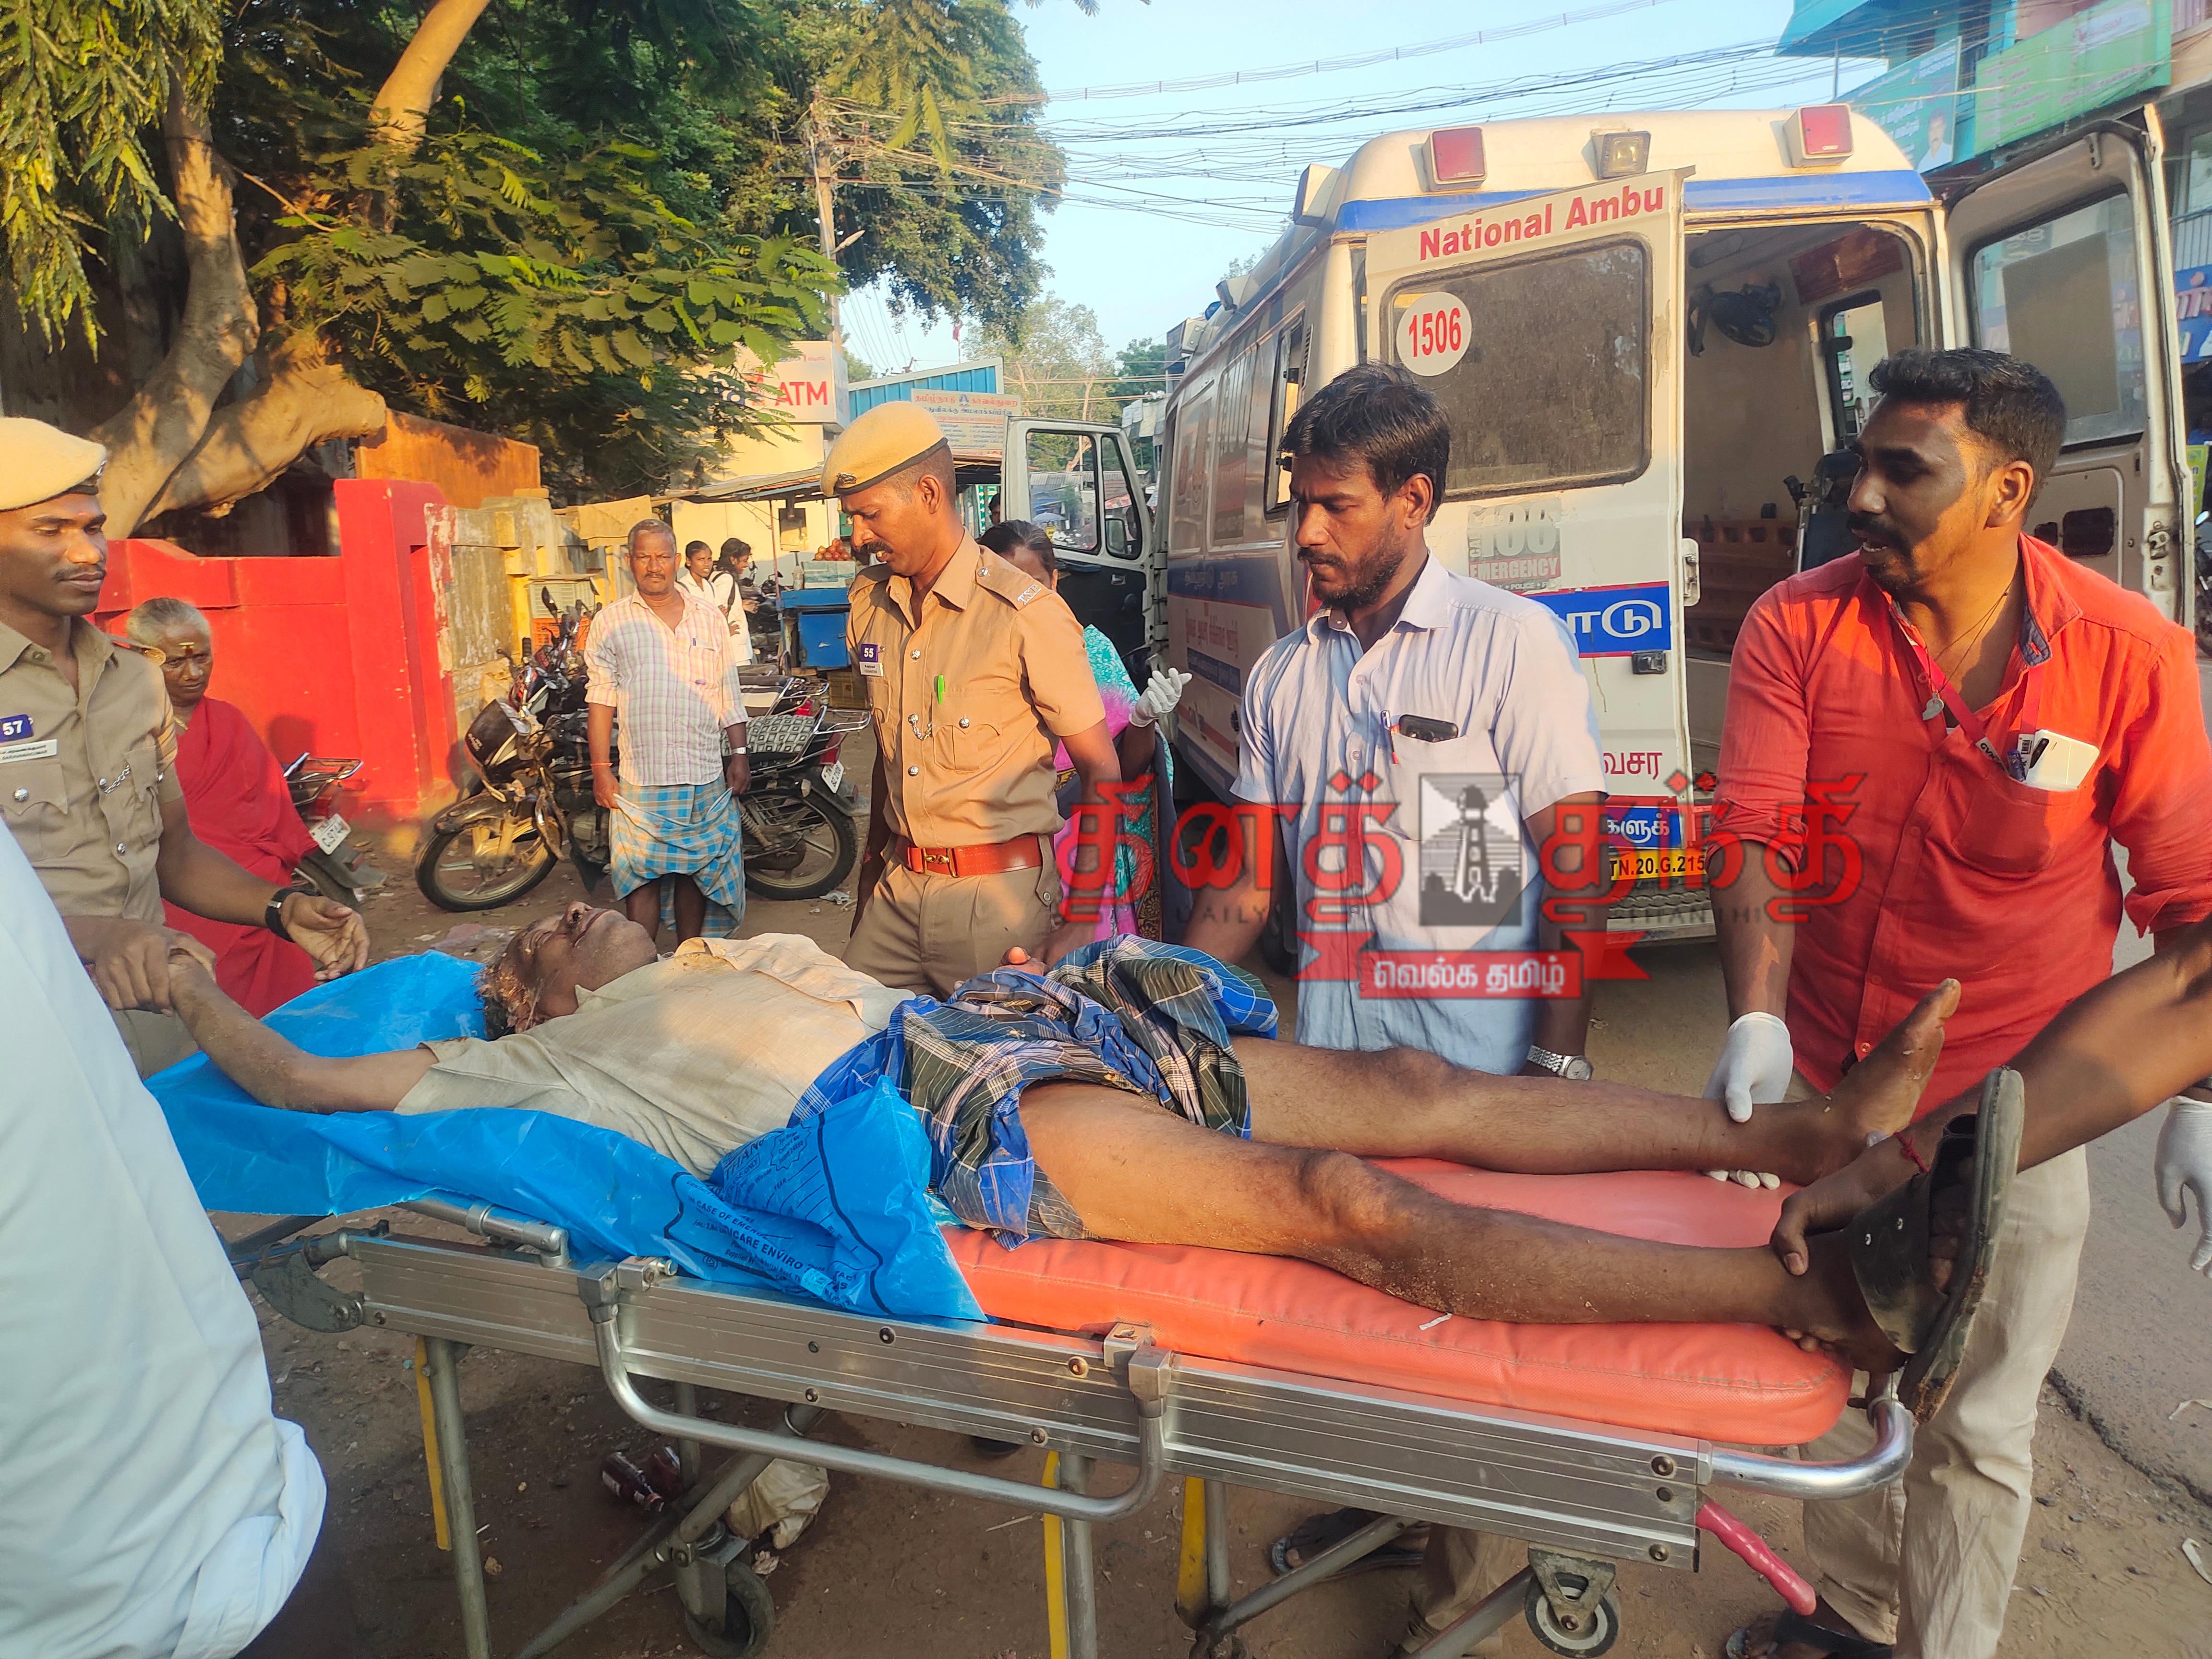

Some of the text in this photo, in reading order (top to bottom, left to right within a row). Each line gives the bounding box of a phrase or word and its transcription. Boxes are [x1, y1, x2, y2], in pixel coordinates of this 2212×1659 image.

[1419, 185, 1664, 261] National Ambu
[1408, 307, 1462, 358] 1506
[775, 381, 828, 406] ATM
[1470, 557, 1558, 580] EMERGENCY
[864, 647, 874, 658] 55
[2, 720, 24, 736] 57
[773, 1178, 787, 1191] YEAR
[696, 1200, 718, 1215] CASE
[719, 1211, 733, 1223] OF
[761, 1244, 804, 1270] ENVIRO
